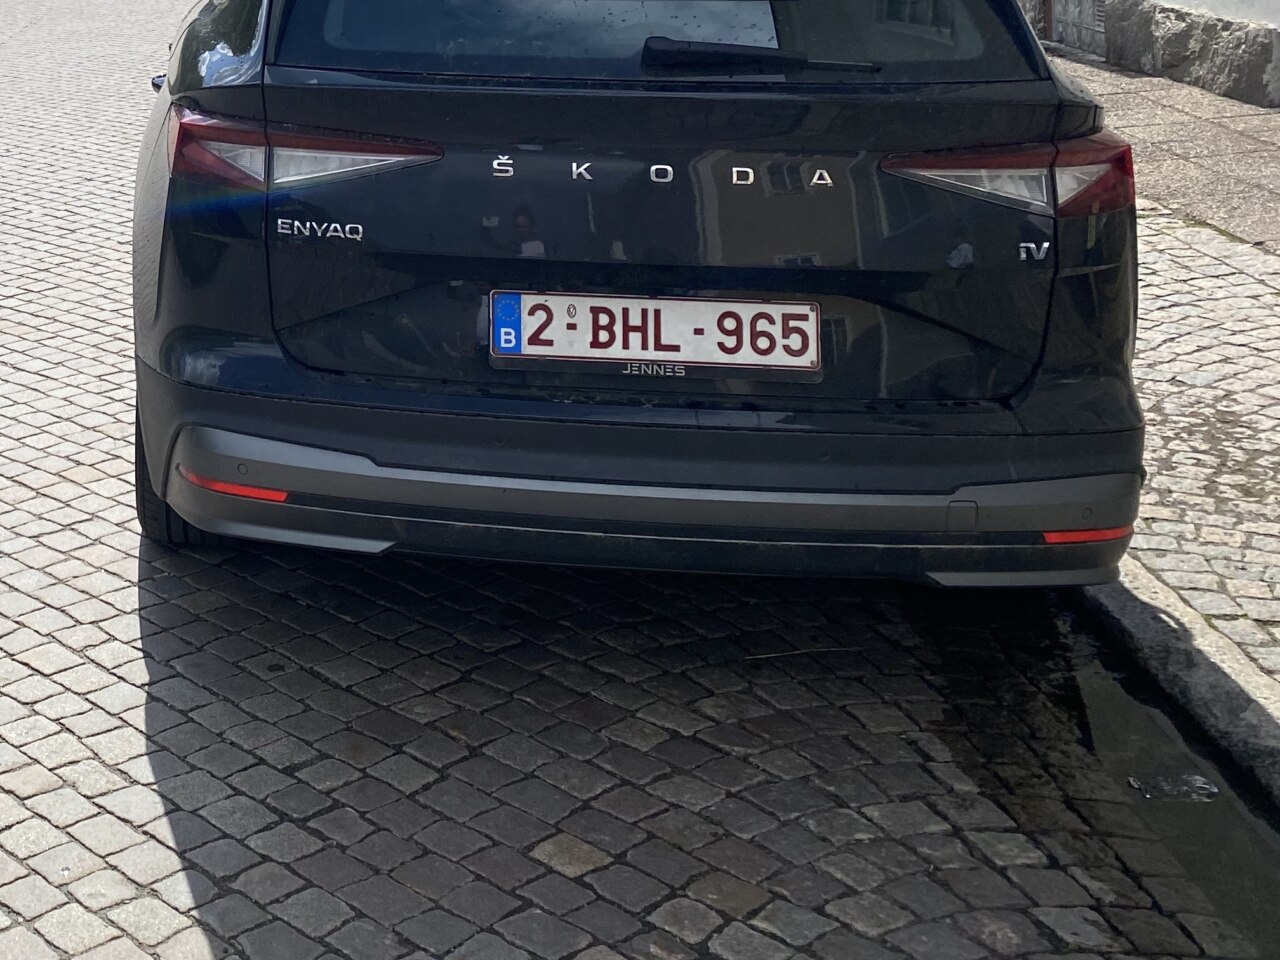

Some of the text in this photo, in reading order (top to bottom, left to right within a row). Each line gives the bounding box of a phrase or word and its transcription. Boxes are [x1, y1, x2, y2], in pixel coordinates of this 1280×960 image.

[492, 155, 835, 187] ŠKODA
[277, 218, 364, 241] ENYAQ
[499, 327, 517, 348] B
[622, 363, 686, 376] JENNES
